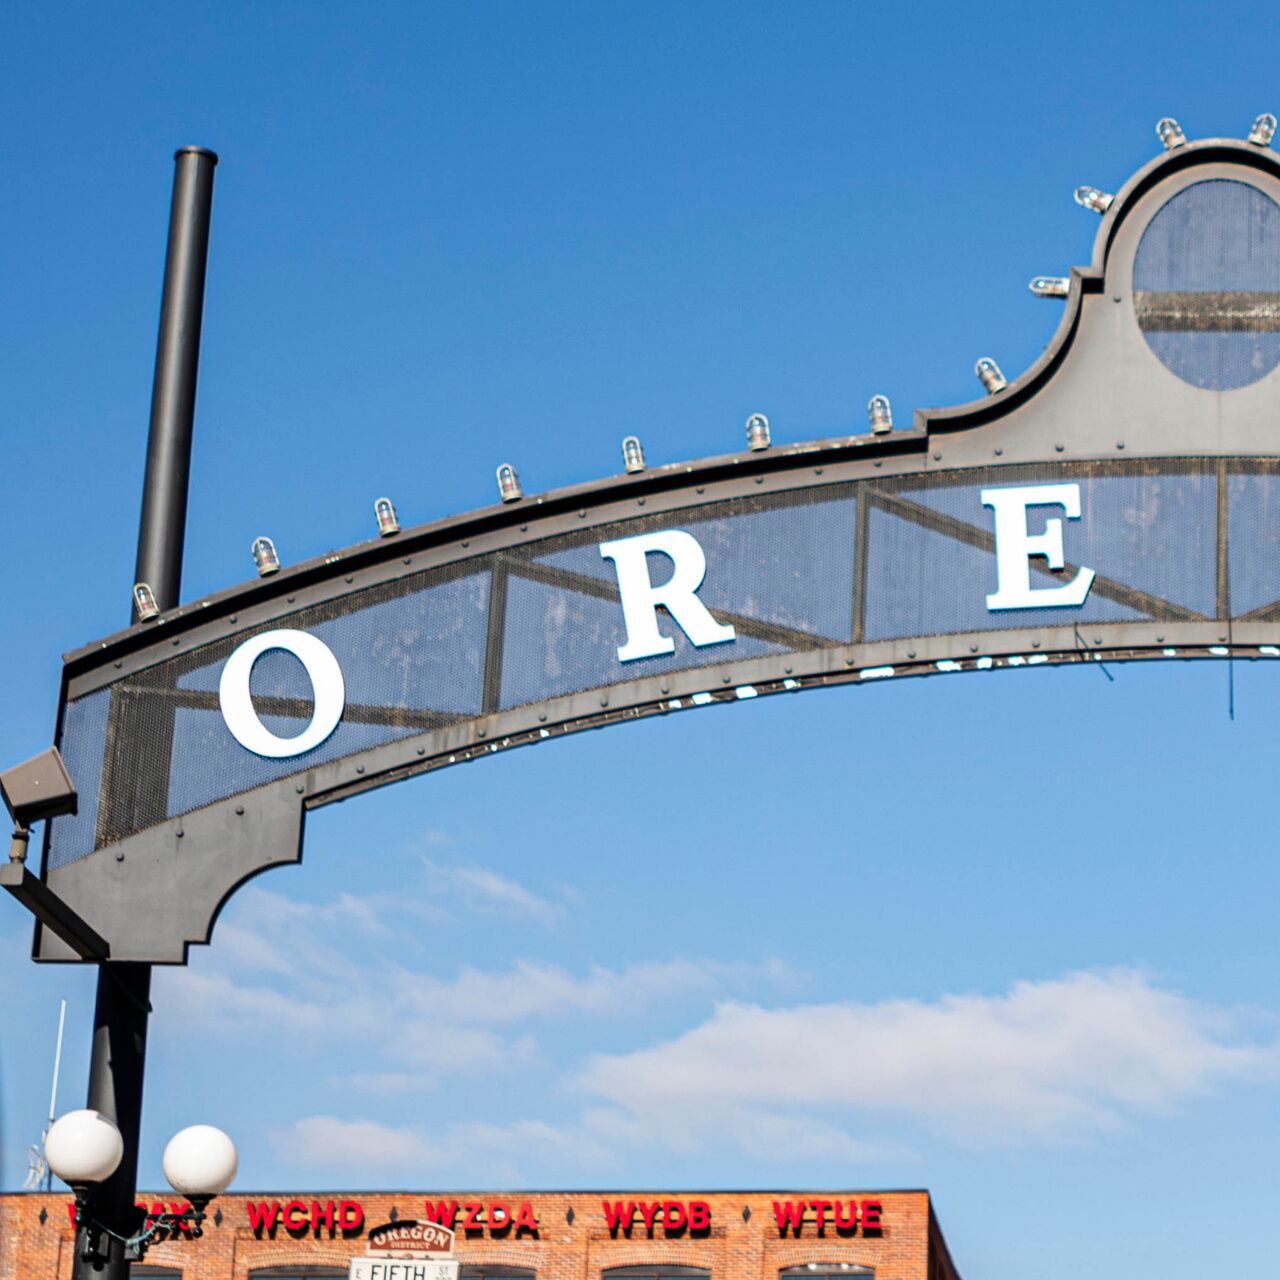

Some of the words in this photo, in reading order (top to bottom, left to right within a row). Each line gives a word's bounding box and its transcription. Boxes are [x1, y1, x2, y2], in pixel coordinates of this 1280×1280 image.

[246, 1200, 364, 1230] WCHD
[424, 1200, 538, 1231] WZDA
[602, 1200, 711, 1230] WYDB
[772, 1200, 882, 1230] WTUE
[373, 1225, 450, 1248] OREGON
[355, 1268, 363, 1280] E
[439, 1265, 450, 1276] ST
